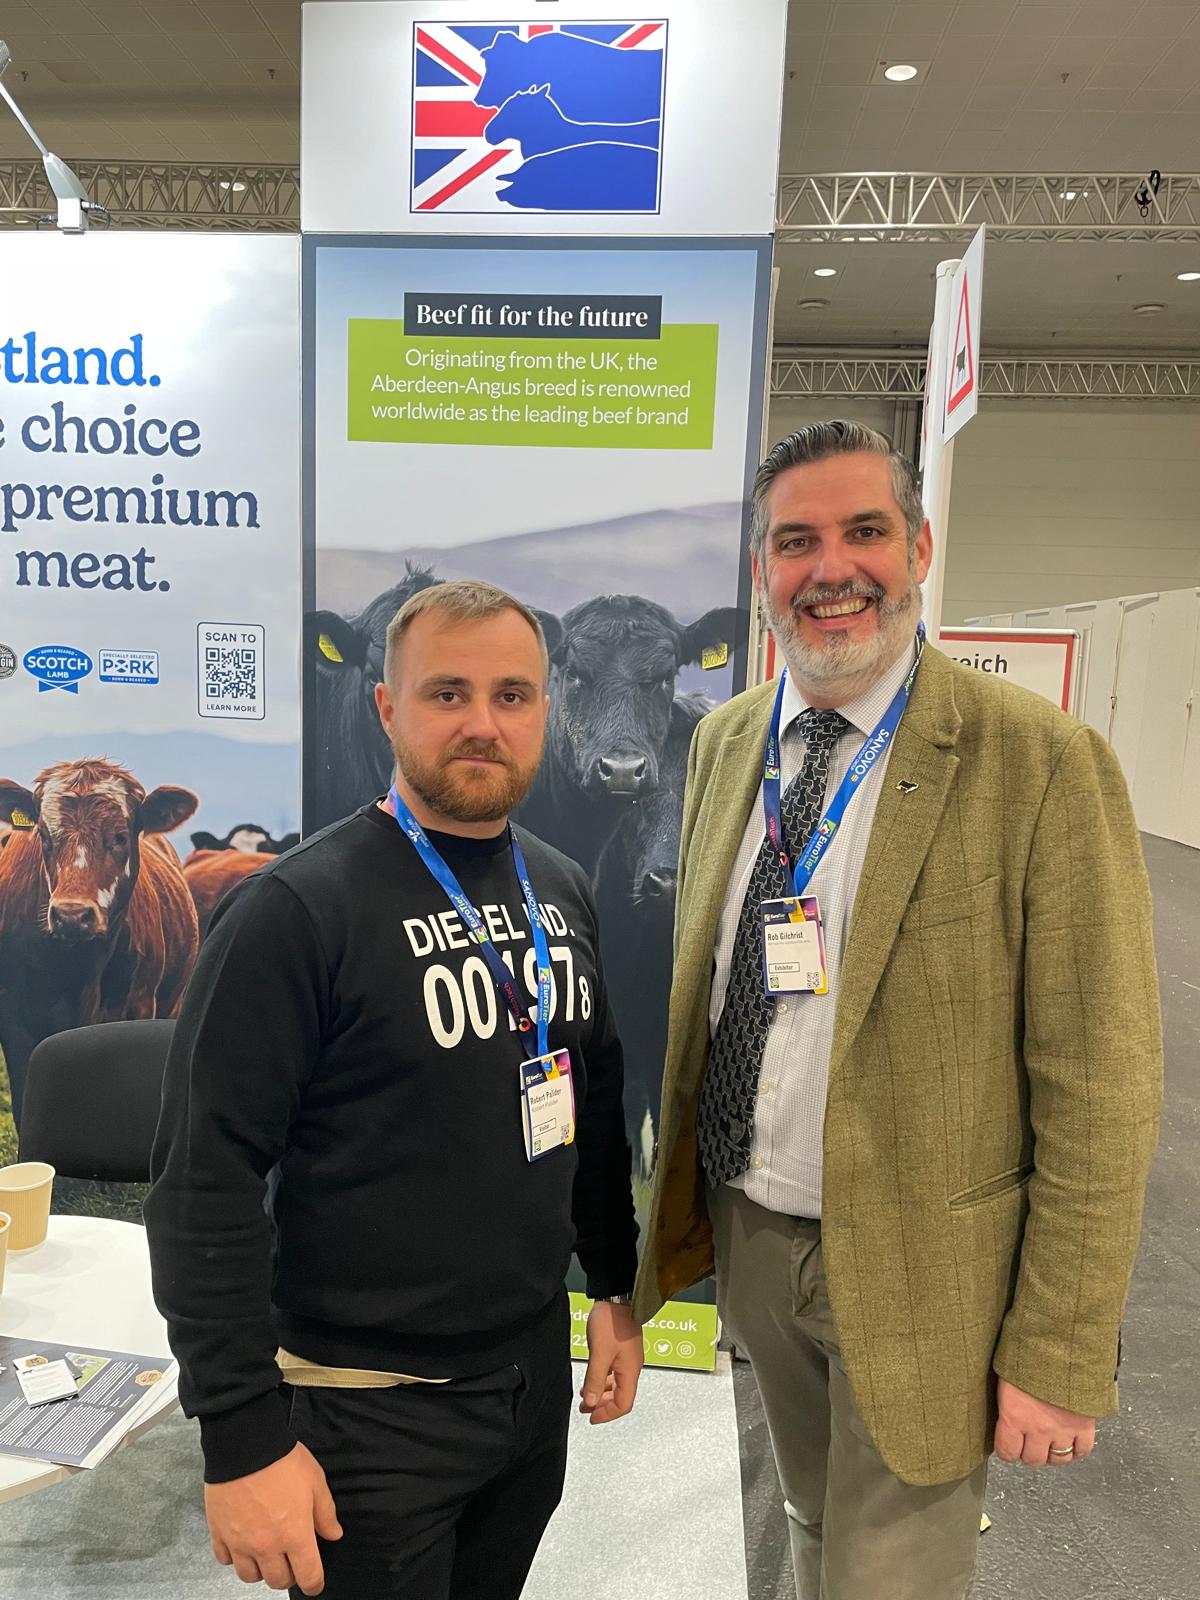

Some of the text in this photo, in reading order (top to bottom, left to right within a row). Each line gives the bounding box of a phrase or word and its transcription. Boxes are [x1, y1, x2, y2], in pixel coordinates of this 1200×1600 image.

[417, 304, 649, 328] Beef fit for the future
[0, 331, 161, 387] tland.
[405, 348, 658, 372] Originating from the UK, the
[370, 374, 691, 399] Aberdeen-Angus breed is renowned
[371, 401, 689, 428] worldwide as the leading beef brand
[21, 401, 202, 457] choice
[1, 473, 260, 532] premium
[16, 547, 170, 592] meat.
[205, 631, 257, 643] SCAN TO
[27, 655, 89, 671] SCOTCH
[47, 671, 70, 679] LAMB
[951, 653, 1008, 673] eich
[206, 703, 257, 713] LEARN MORE
[855, 728, 890, 775] SANOVO
[522, 879, 541, 922] SANOVO
[767, 933, 779, 941] Rob
